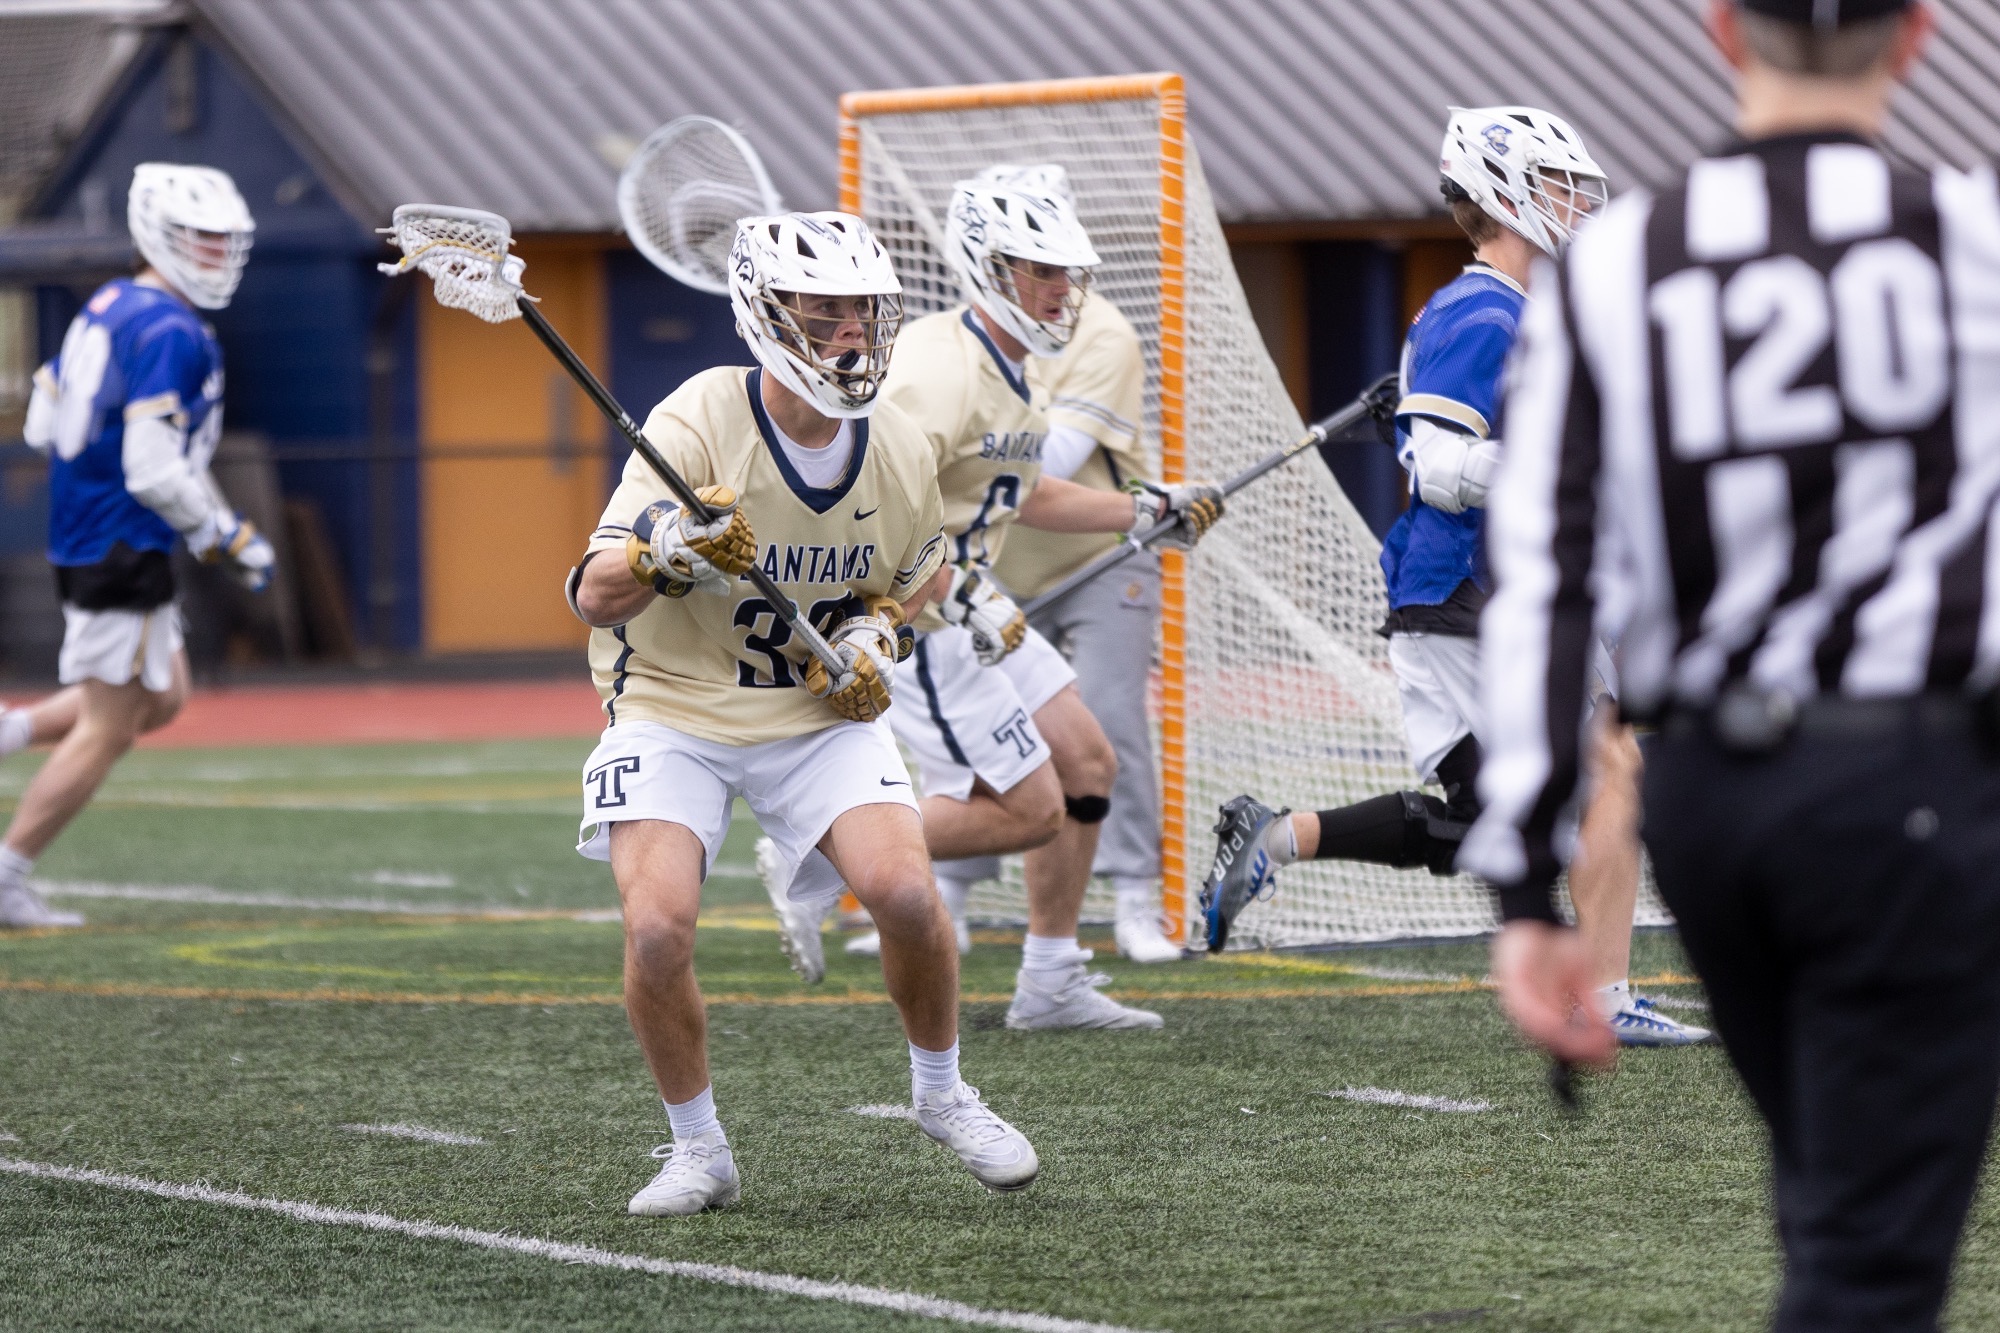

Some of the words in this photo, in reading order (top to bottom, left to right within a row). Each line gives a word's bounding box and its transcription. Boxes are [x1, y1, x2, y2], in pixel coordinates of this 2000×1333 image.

[1650, 238, 1951, 461] 120
[739, 543, 875, 583] ANTAMS
[992, 708, 1037, 760] T
[586, 756, 640, 808] T
[1213, 803, 1262, 882] VAPOR
